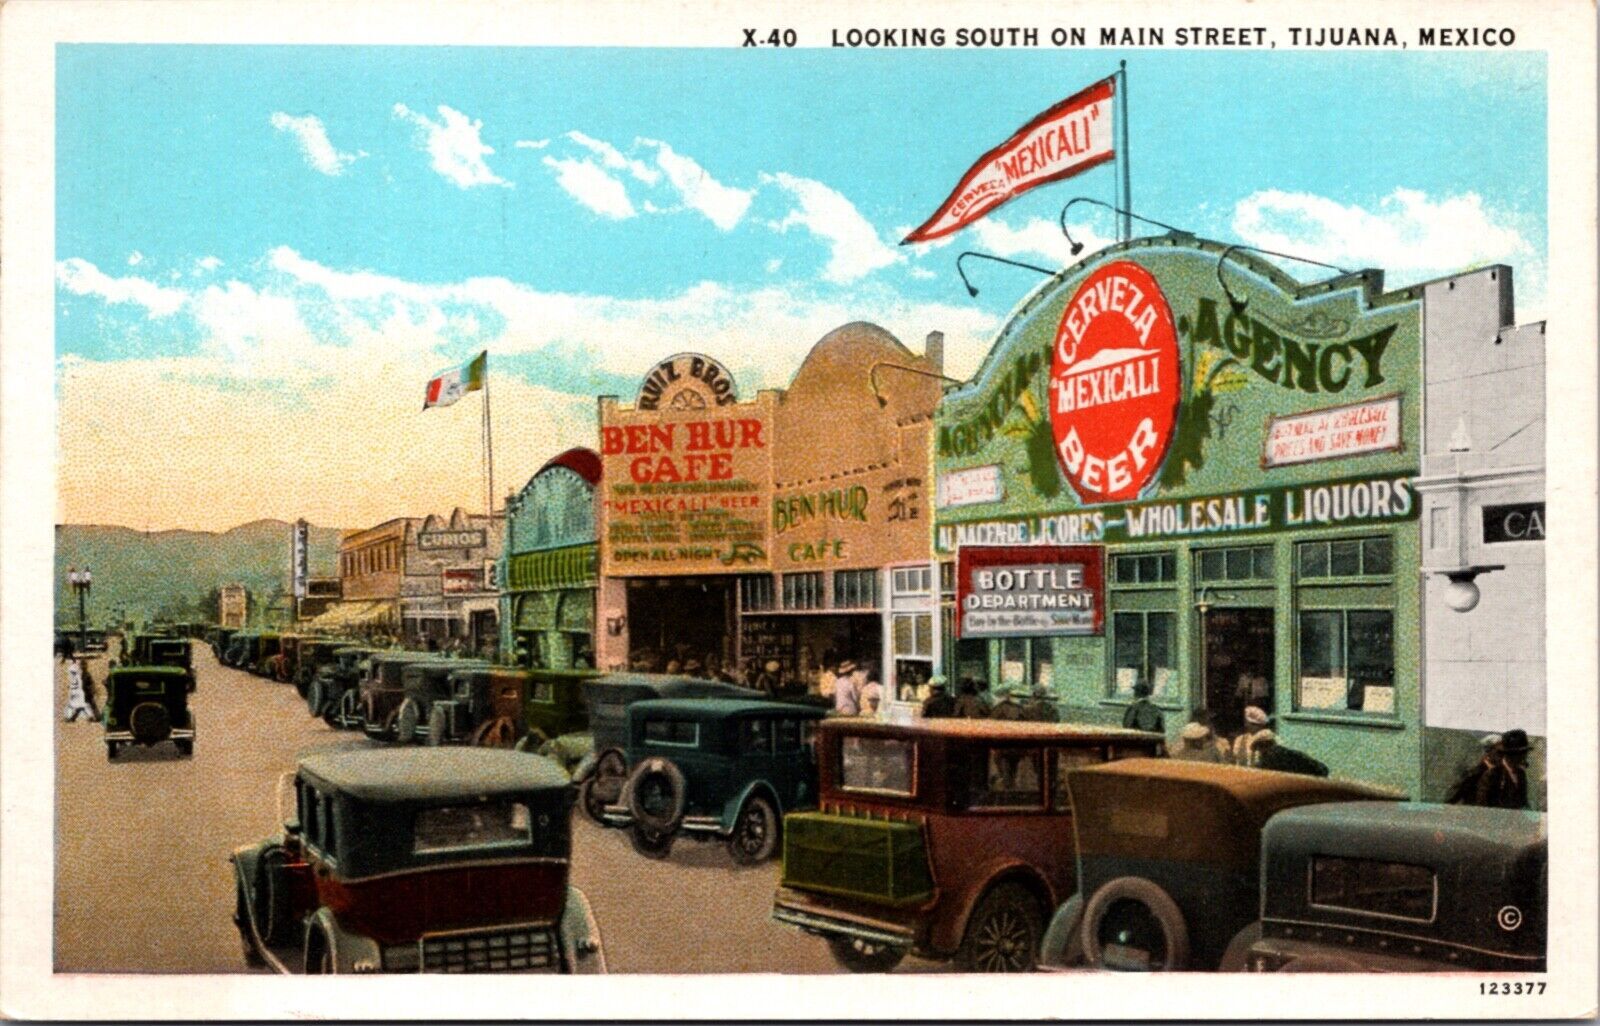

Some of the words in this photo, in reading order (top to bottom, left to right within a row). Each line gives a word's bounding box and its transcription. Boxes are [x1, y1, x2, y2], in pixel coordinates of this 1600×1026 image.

[1058, 275, 1158, 364] CERVEZA
[1193, 297, 1399, 394] AGENCY
[639, 361, 681, 410] RUIZ
[602, 424, 676, 456] BEN
[684, 418, 766, 451] HUR
[1059, 417, 1159, 494] BEER
[629, 452, 733, 484] CAFE
[720, 496, 760, 508] BEER
[773, 494, 816, 534] BEN
[818, 484, 868, 522] HUR
[1126, 494, 1271, 538] WHOLESALE
[1285, 477, 1413, 526] LIQUORS
[614, 548, 649, 562] OPEN
[651, 548, 677, 561] ALL
[678, 545, 721, 561] NIGHT
[788, 538, 849, 561] CAFE
[978, 569, 1082, 591] BOTTLE
[967, 593, 1094, 610] DEPARTMENT
